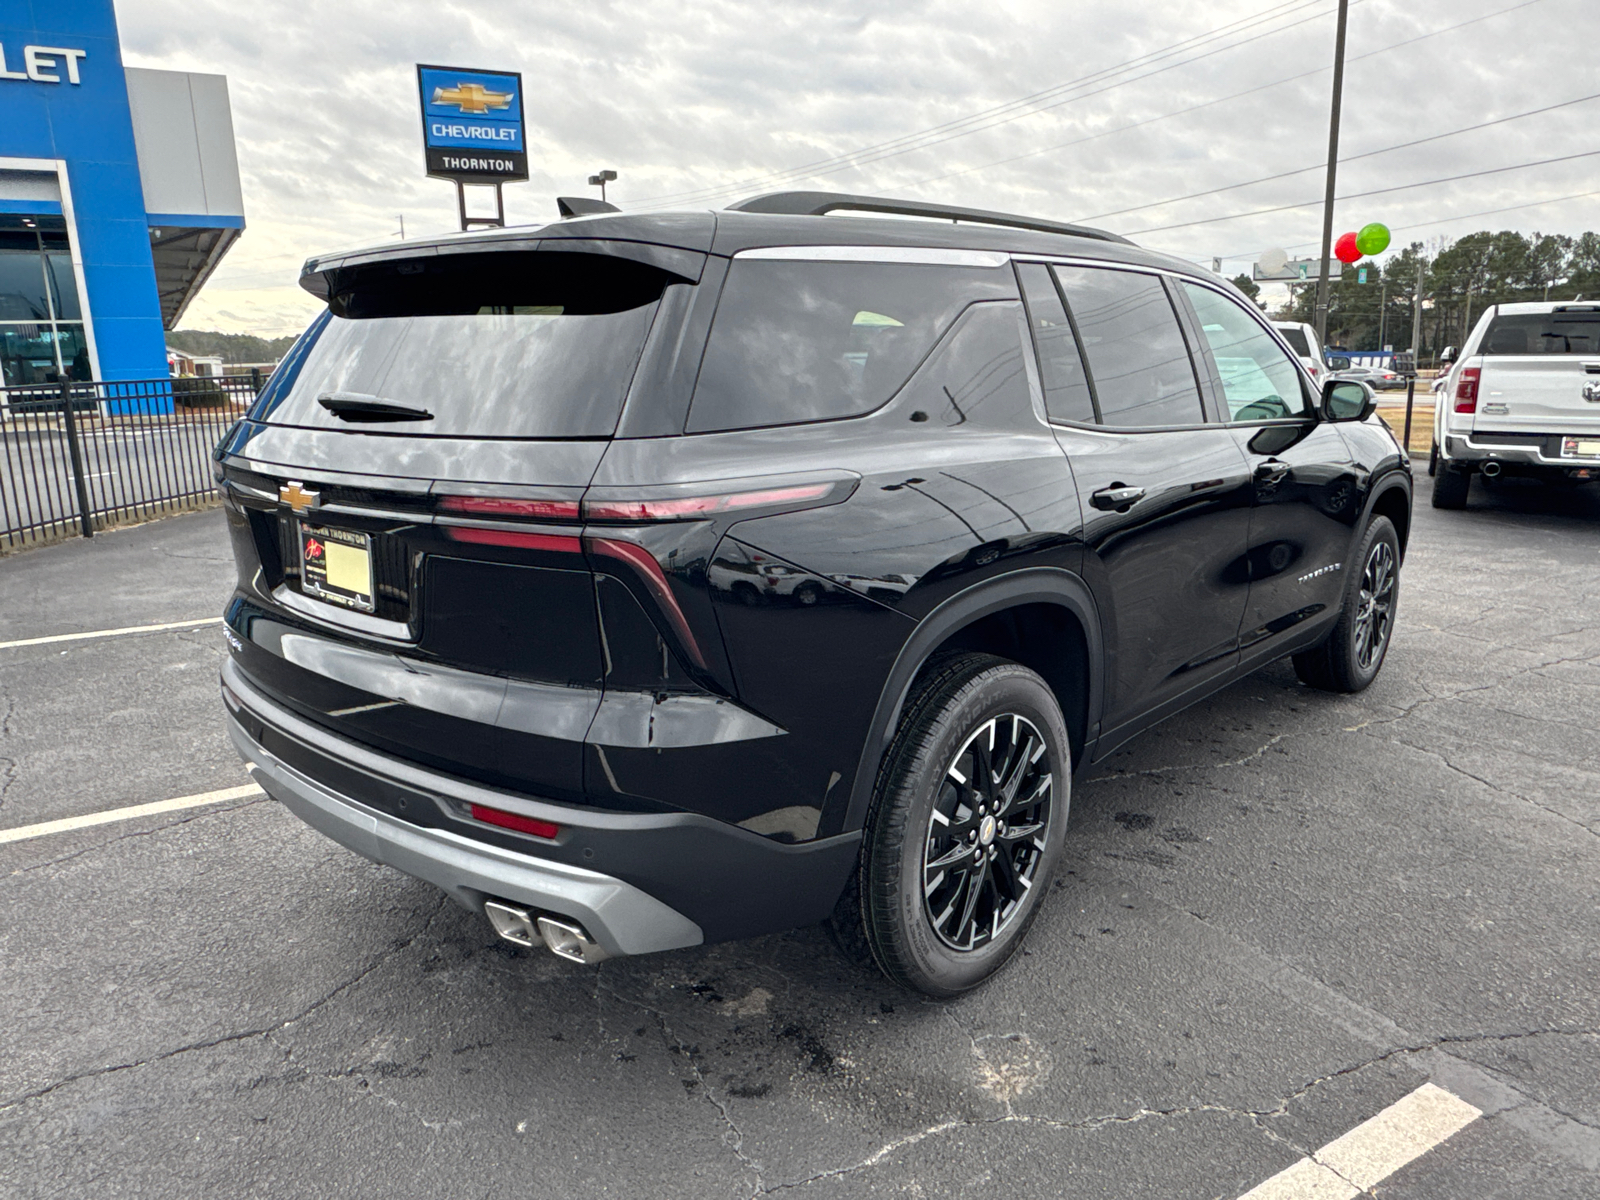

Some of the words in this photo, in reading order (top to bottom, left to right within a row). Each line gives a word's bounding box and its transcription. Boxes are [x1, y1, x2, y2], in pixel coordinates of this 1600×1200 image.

[0, 42, 86, 84] LET
[432, 124, 517, 141] CHEVROLET
[442, 157, 514, 171] THORNTON
[329, 528, 365, 545] THORNTON
